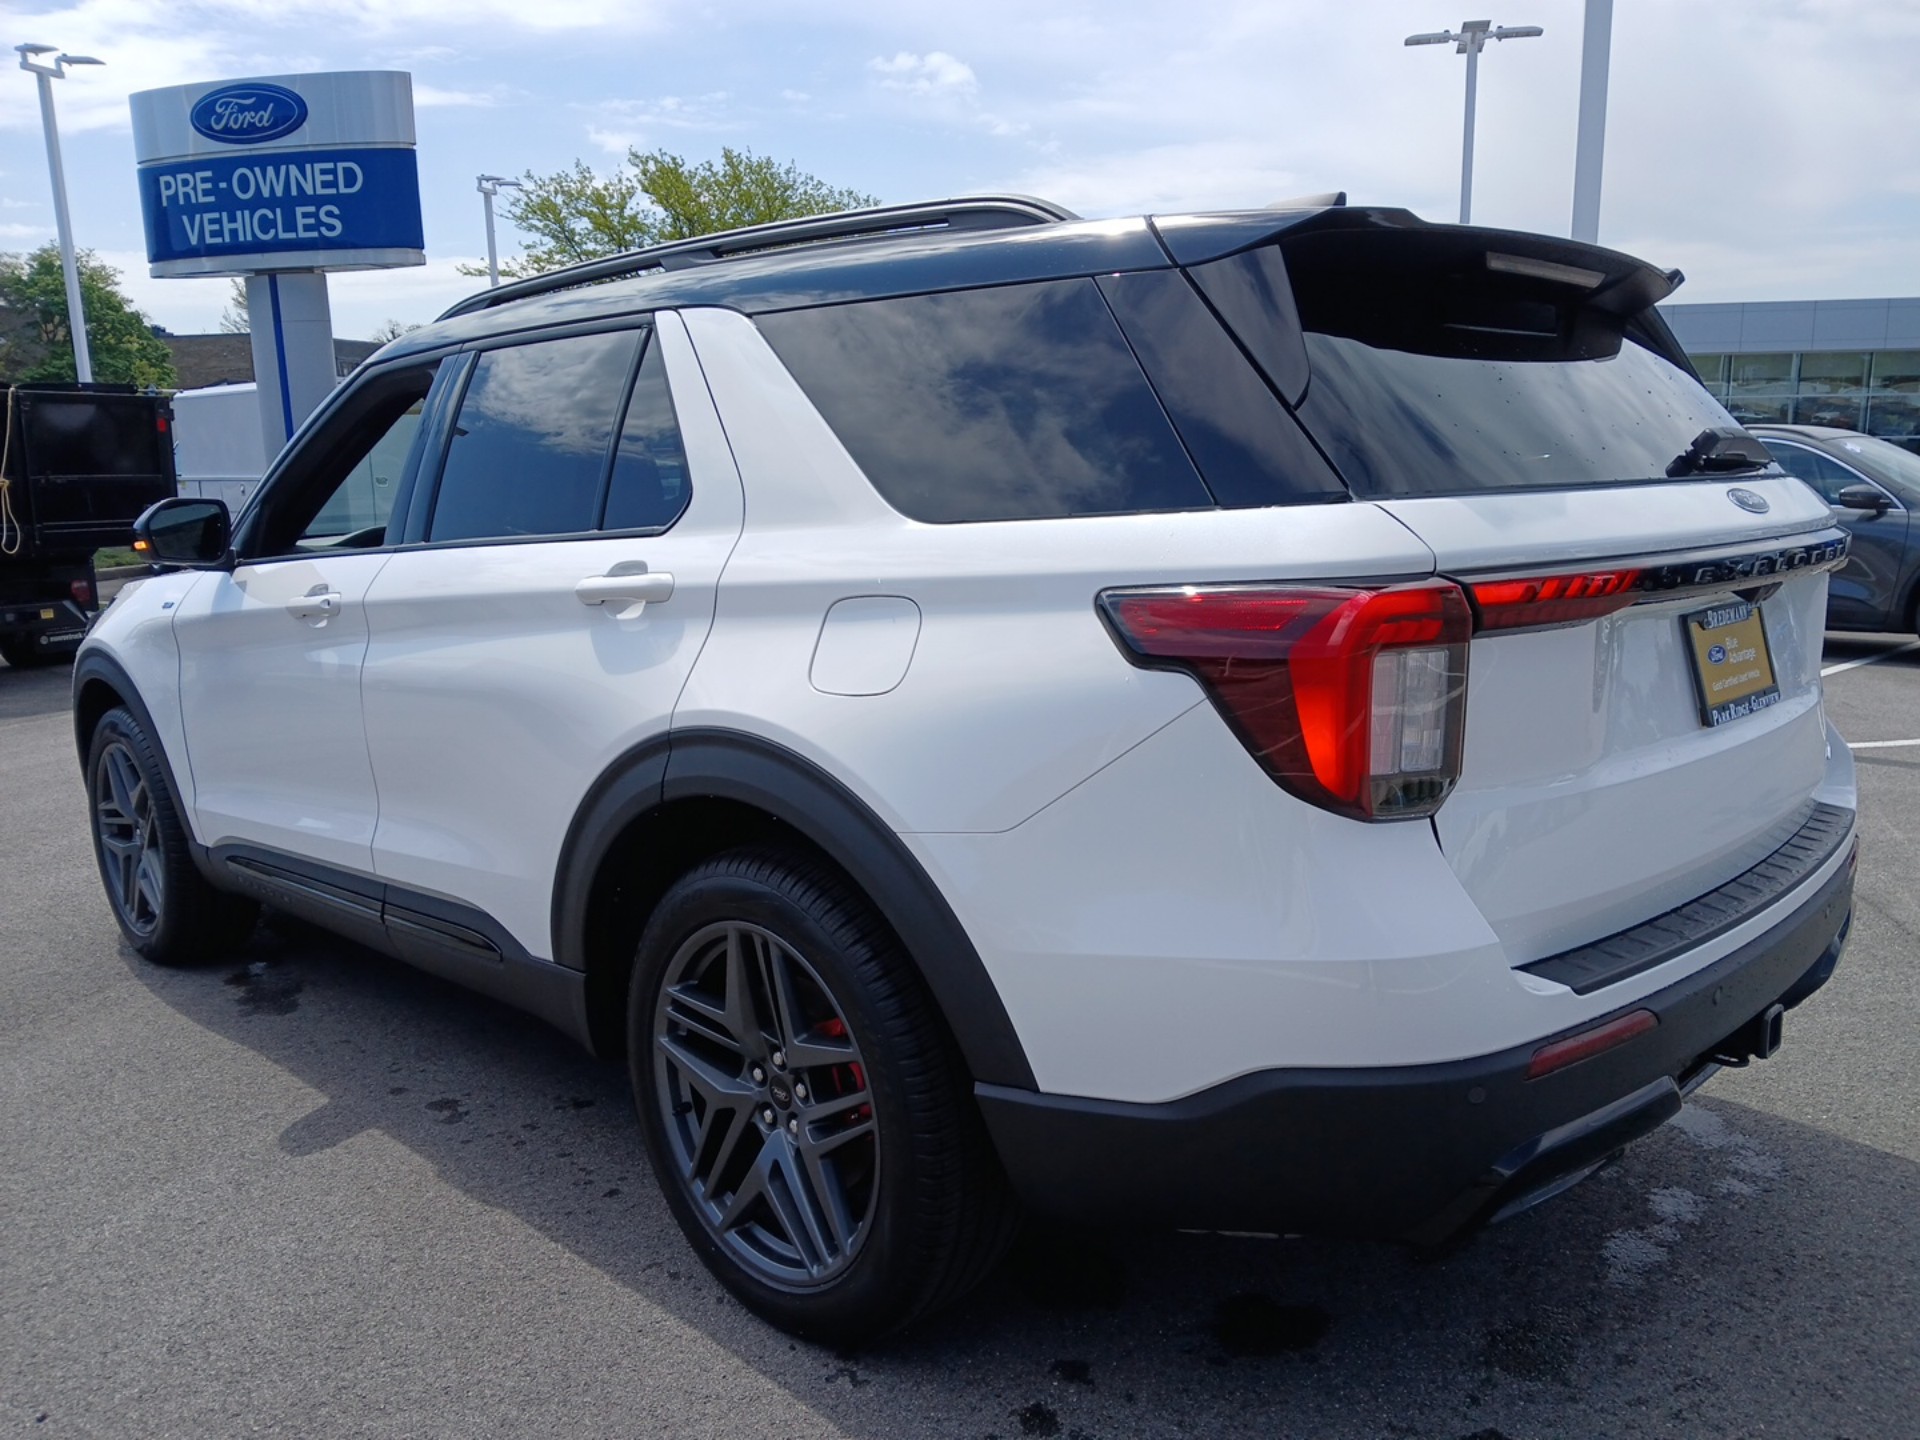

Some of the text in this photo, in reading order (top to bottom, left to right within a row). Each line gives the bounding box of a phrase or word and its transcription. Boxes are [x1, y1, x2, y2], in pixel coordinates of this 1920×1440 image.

[210, 97, 274, 131] Ford
[159, 161, 364, 207] PRE-OWNED
[182, 204, 343, 245] VEHICLES
